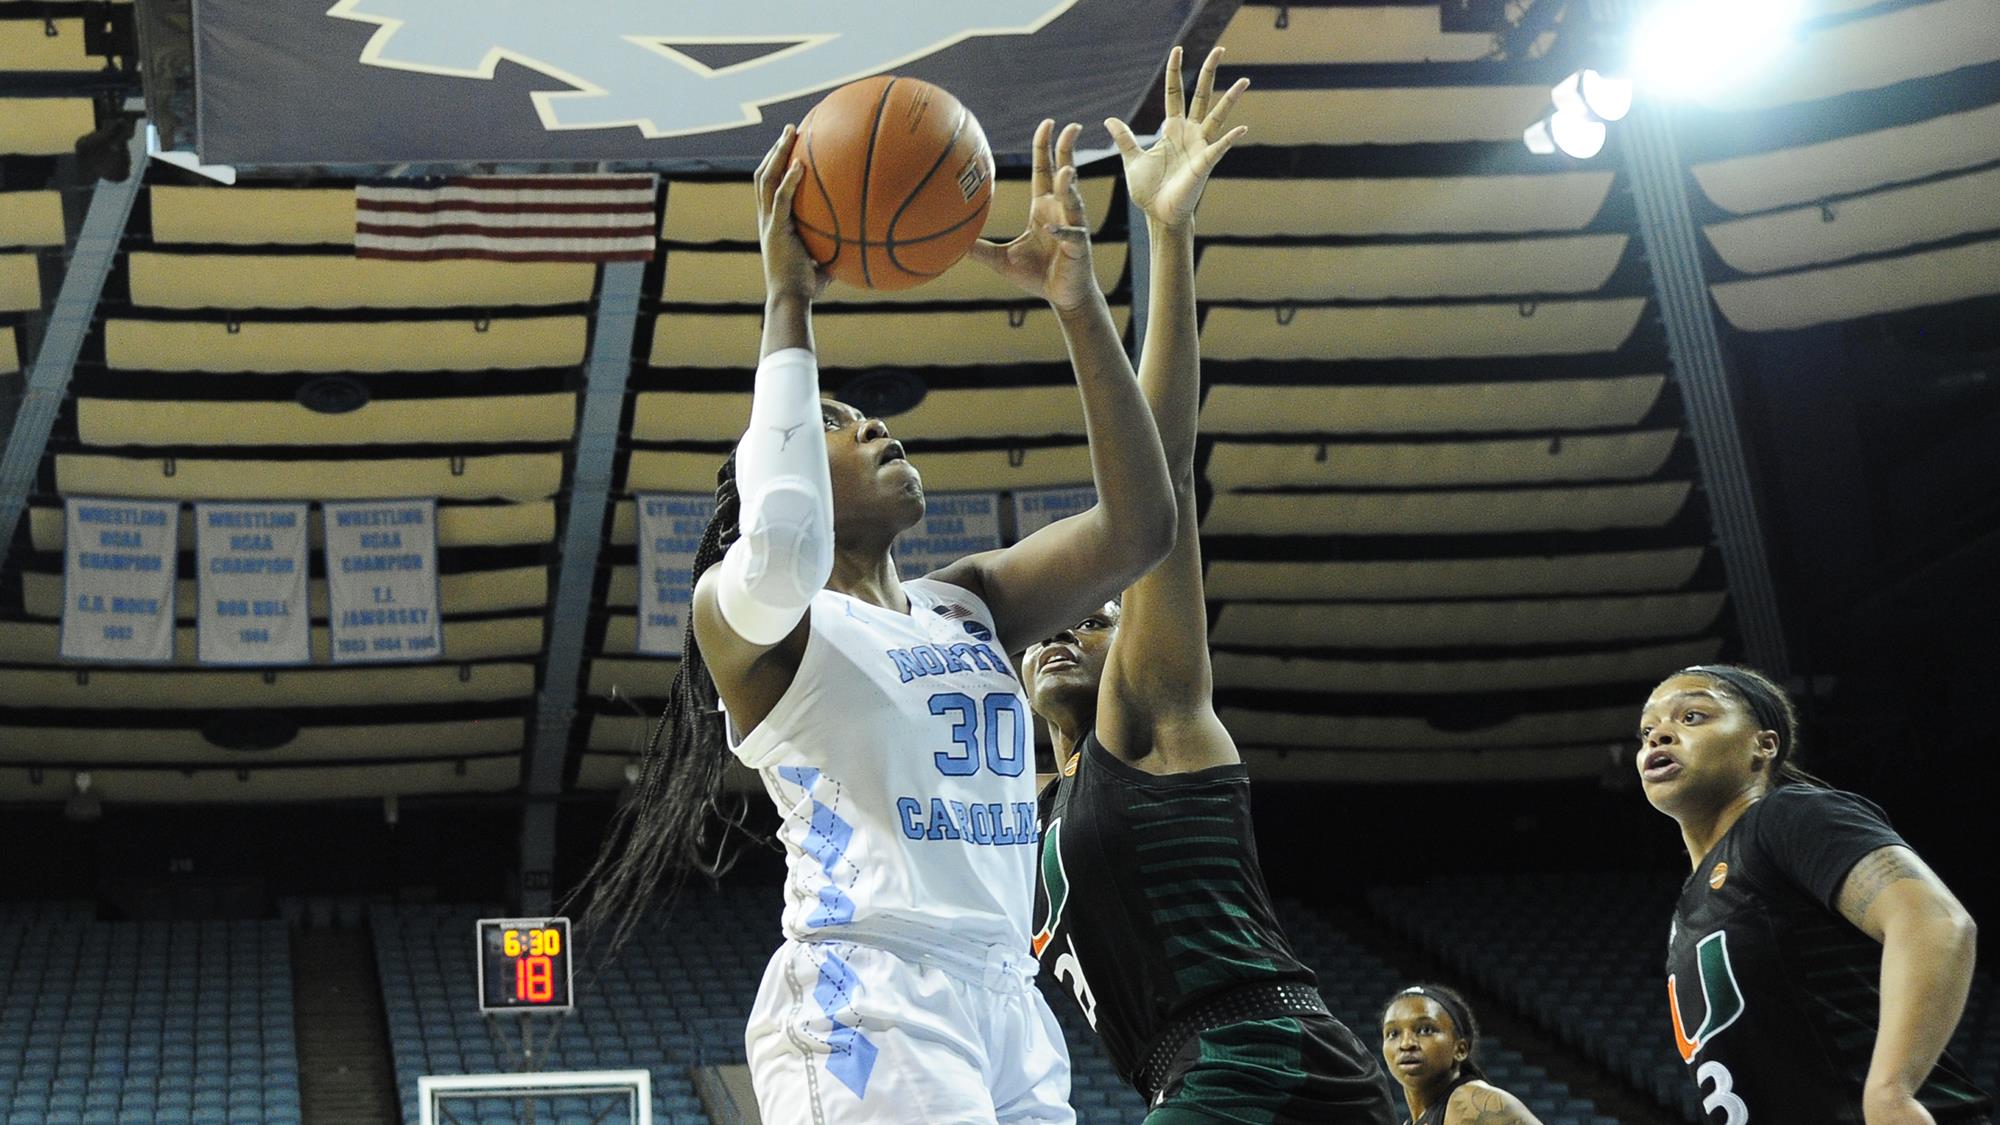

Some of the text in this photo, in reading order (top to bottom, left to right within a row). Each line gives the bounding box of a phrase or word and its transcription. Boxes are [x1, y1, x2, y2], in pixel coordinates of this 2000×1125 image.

[79, 507, 166, 525] WRESTLING
[208, 512, 296, 527] WRESTLING
[336, 509, 423, 526] WRESTLING
[100, 530, 142, 547] NCAA
[230, 535, 272, 550] NCAA
[360, 532, 401, 548] NCAA
[79, 553, 161, 571] CHAMPION
[211, 557, 294, 573] CHAMPION
[341, 554, 423, 573] CHAMPION
[928, 692, 1026, 778] 30
[897, 797, 1038, 846] CAROLIN
[503, 929, 561, 957] 6:30
[516, 954, 554, 1004] 18
[1696, 1059, 1749, 1125] 3
